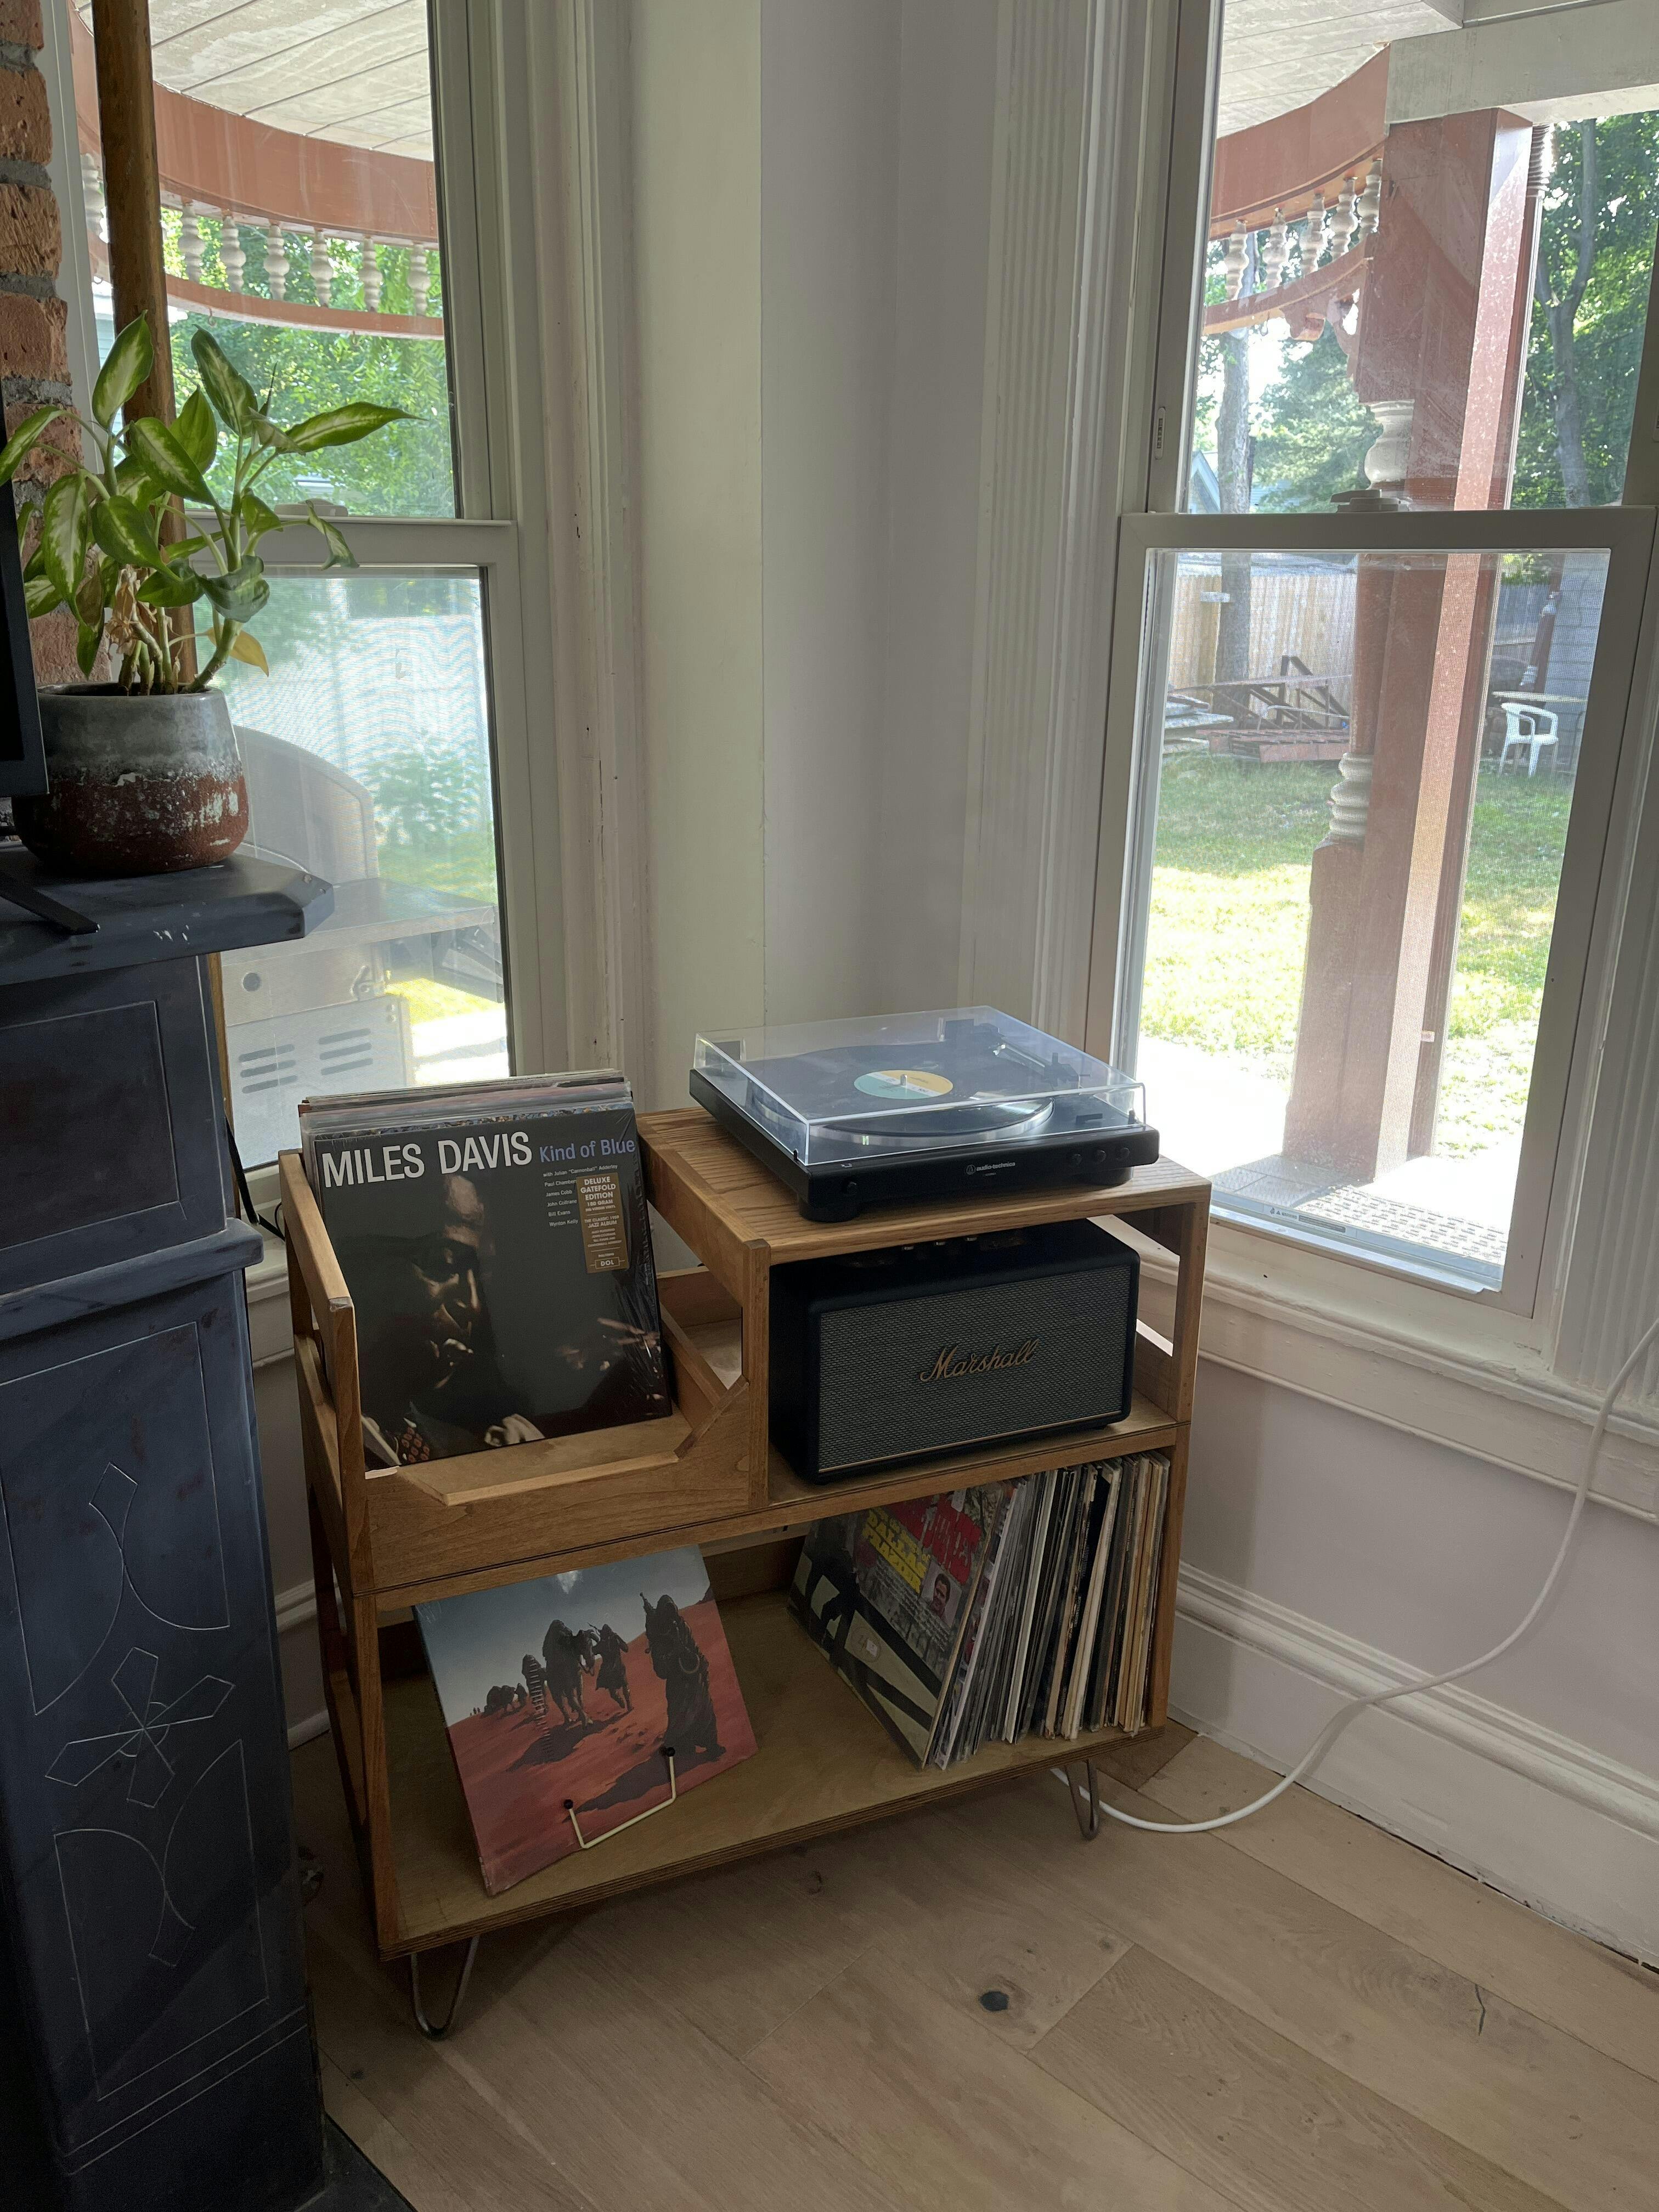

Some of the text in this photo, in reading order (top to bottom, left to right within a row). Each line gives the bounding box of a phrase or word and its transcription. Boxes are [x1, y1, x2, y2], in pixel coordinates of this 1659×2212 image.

[539, 1138, 636, 1163] Kind of Blue
[322, 1131, 533, 1188] MILES DAVIS
[977, 1162, 1015, 1171] audio-technica
[580, 1183, 616, 1193] GATEFOLD
[584, 1176, 611, 1186] DELUXE
[585, 1192, 613, 1201] EDITION
[919, 1338, 1040, 1382] Marshall
[865, 1508, 927, 1580] DALLAS
